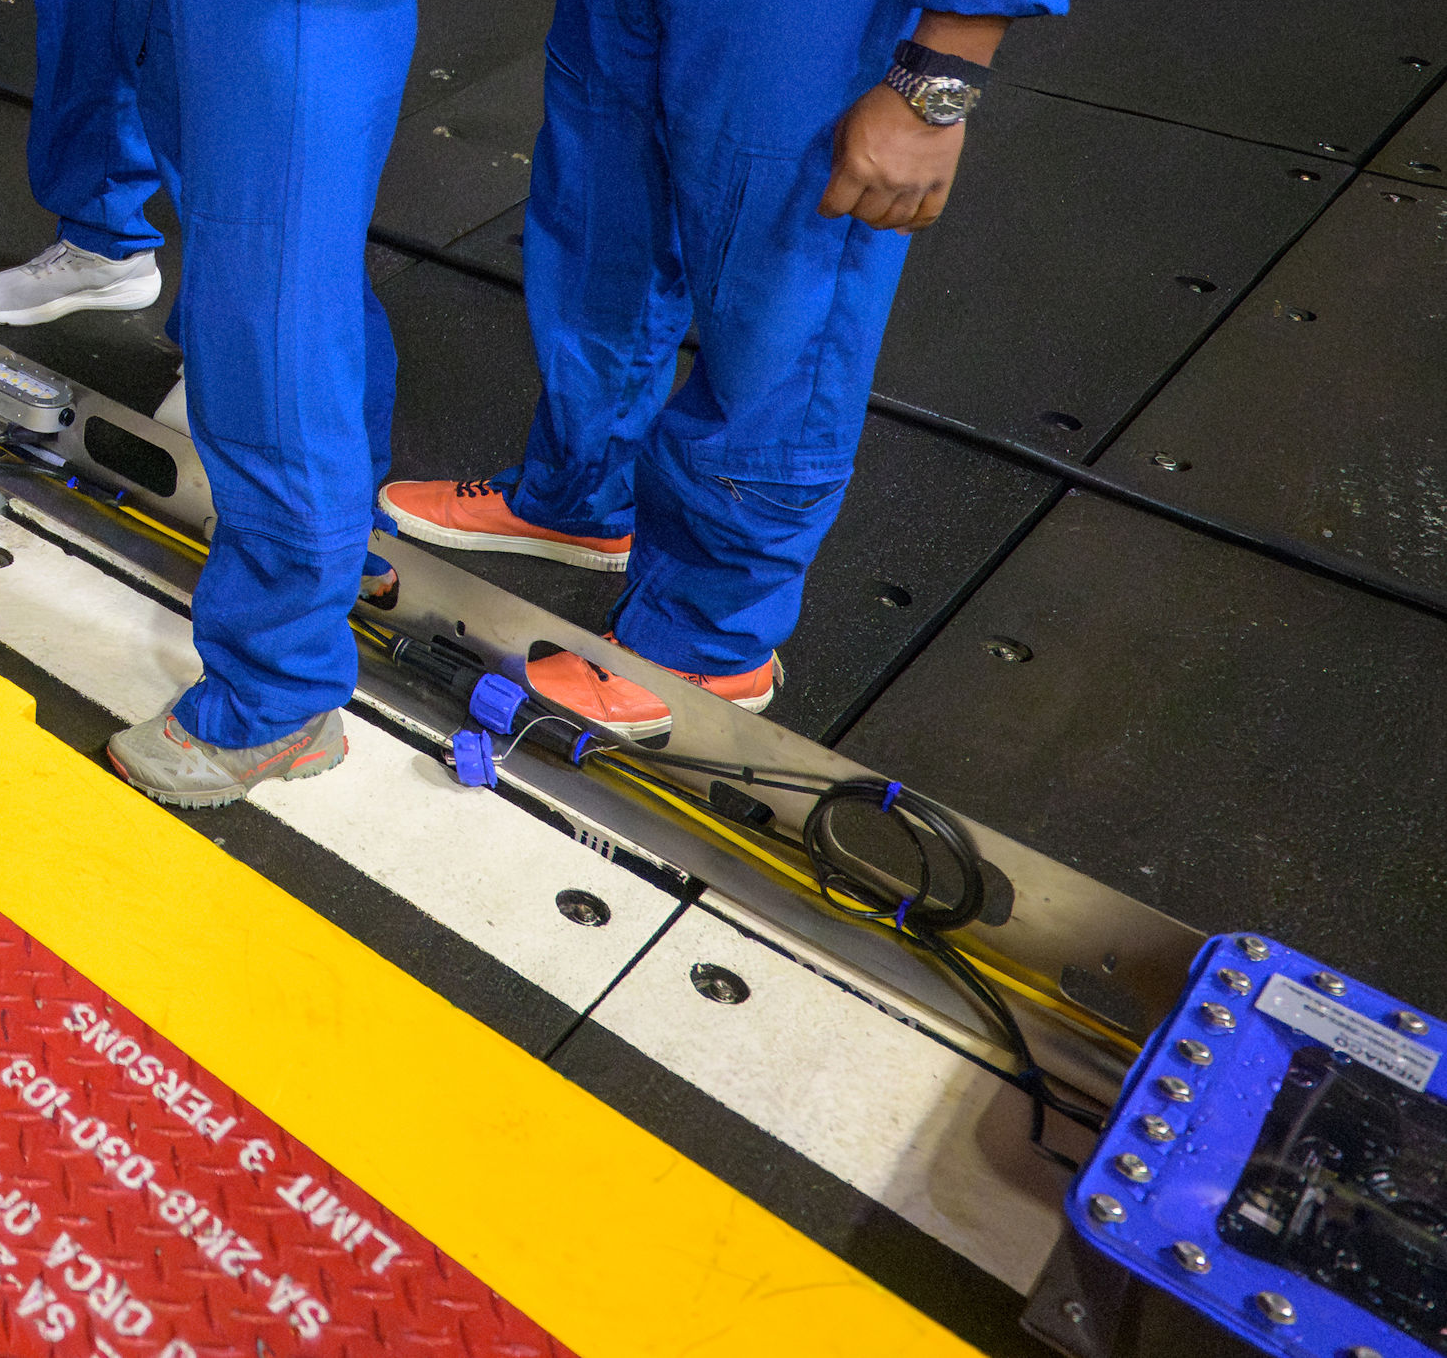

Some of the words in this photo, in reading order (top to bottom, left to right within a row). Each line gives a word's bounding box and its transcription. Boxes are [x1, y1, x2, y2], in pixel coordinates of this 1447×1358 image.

[62, 1002, 238, 1143] PERSONS
[0, 1058, 330, 1339] SA-2K18-030-103
[239, 1139, 276, 1173] 3
[276, 1175, 402, 1274] LIMIT
[44, 1231, 154, 1337] ORCA
